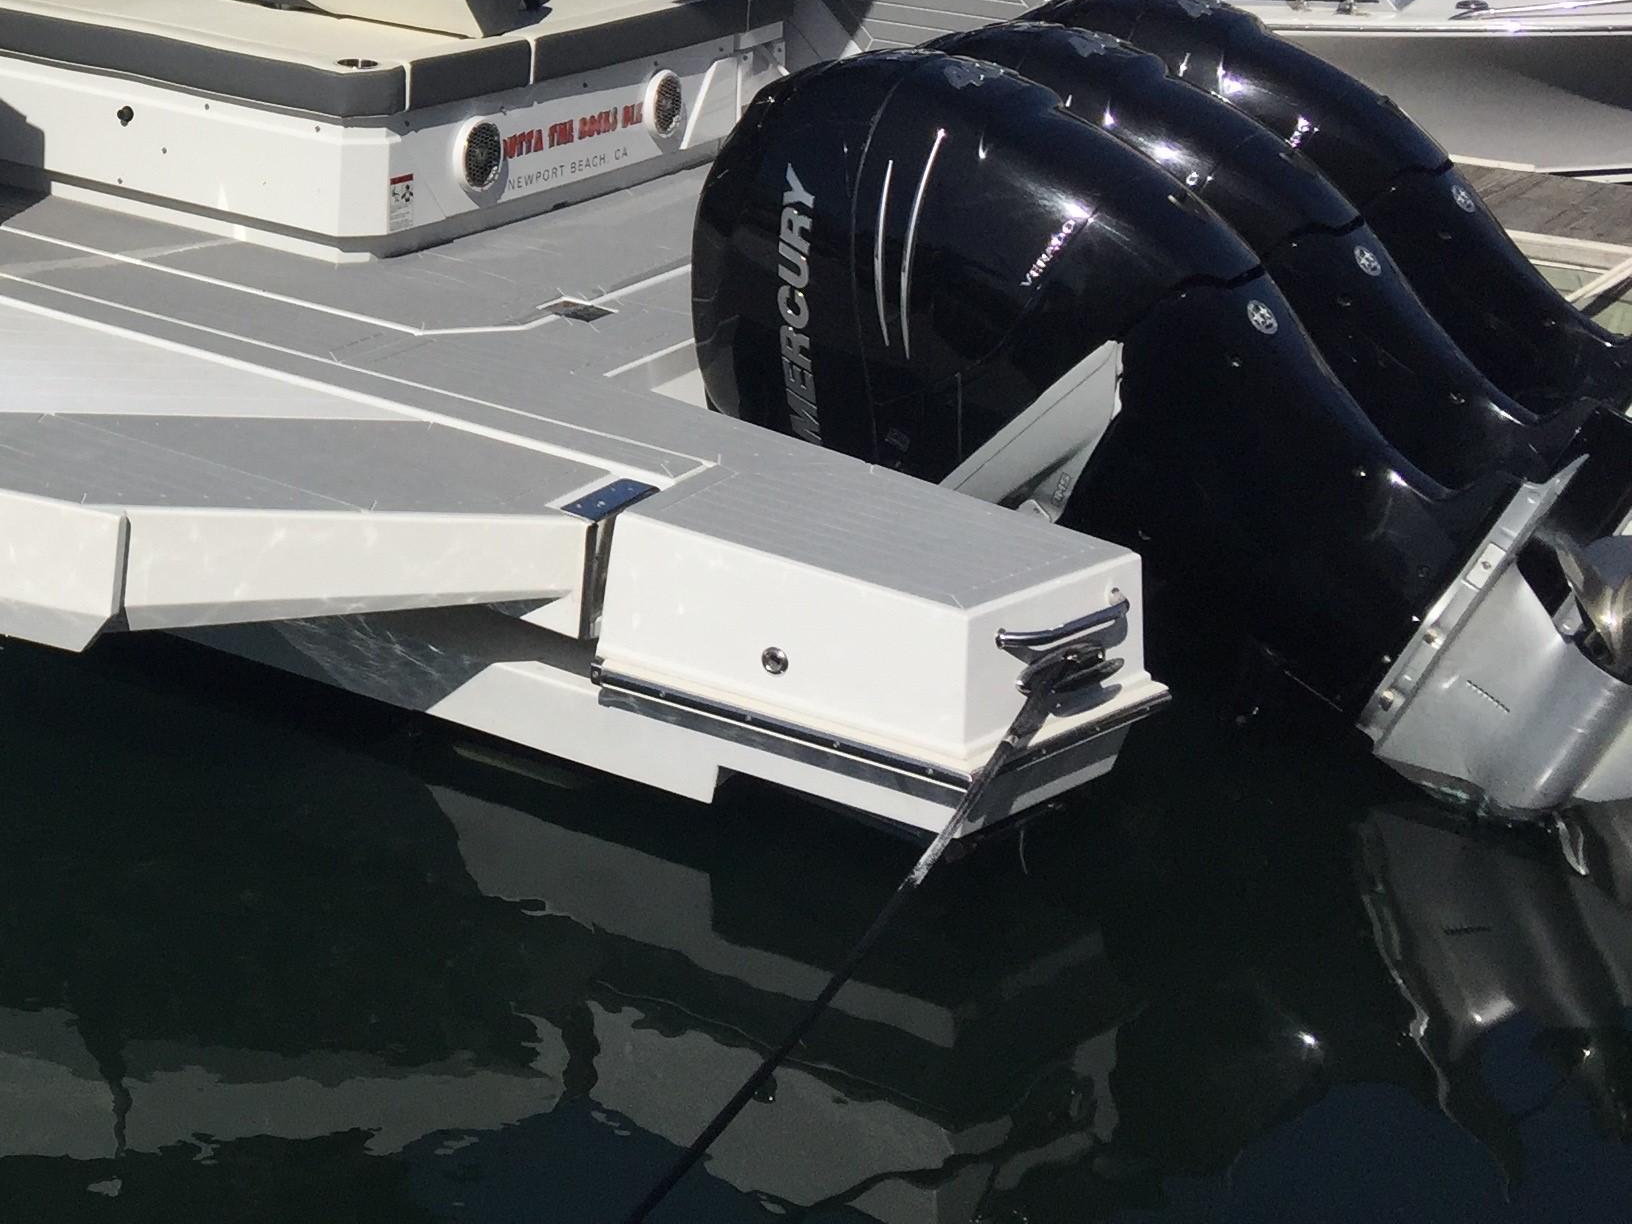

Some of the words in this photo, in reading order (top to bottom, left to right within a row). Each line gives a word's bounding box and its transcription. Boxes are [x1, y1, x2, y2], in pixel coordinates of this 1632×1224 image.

[507, 164, 565, 190] NEWPORT
[614, 147, 628, 161] CA
[777, 163, 821, 444] MERCURY
